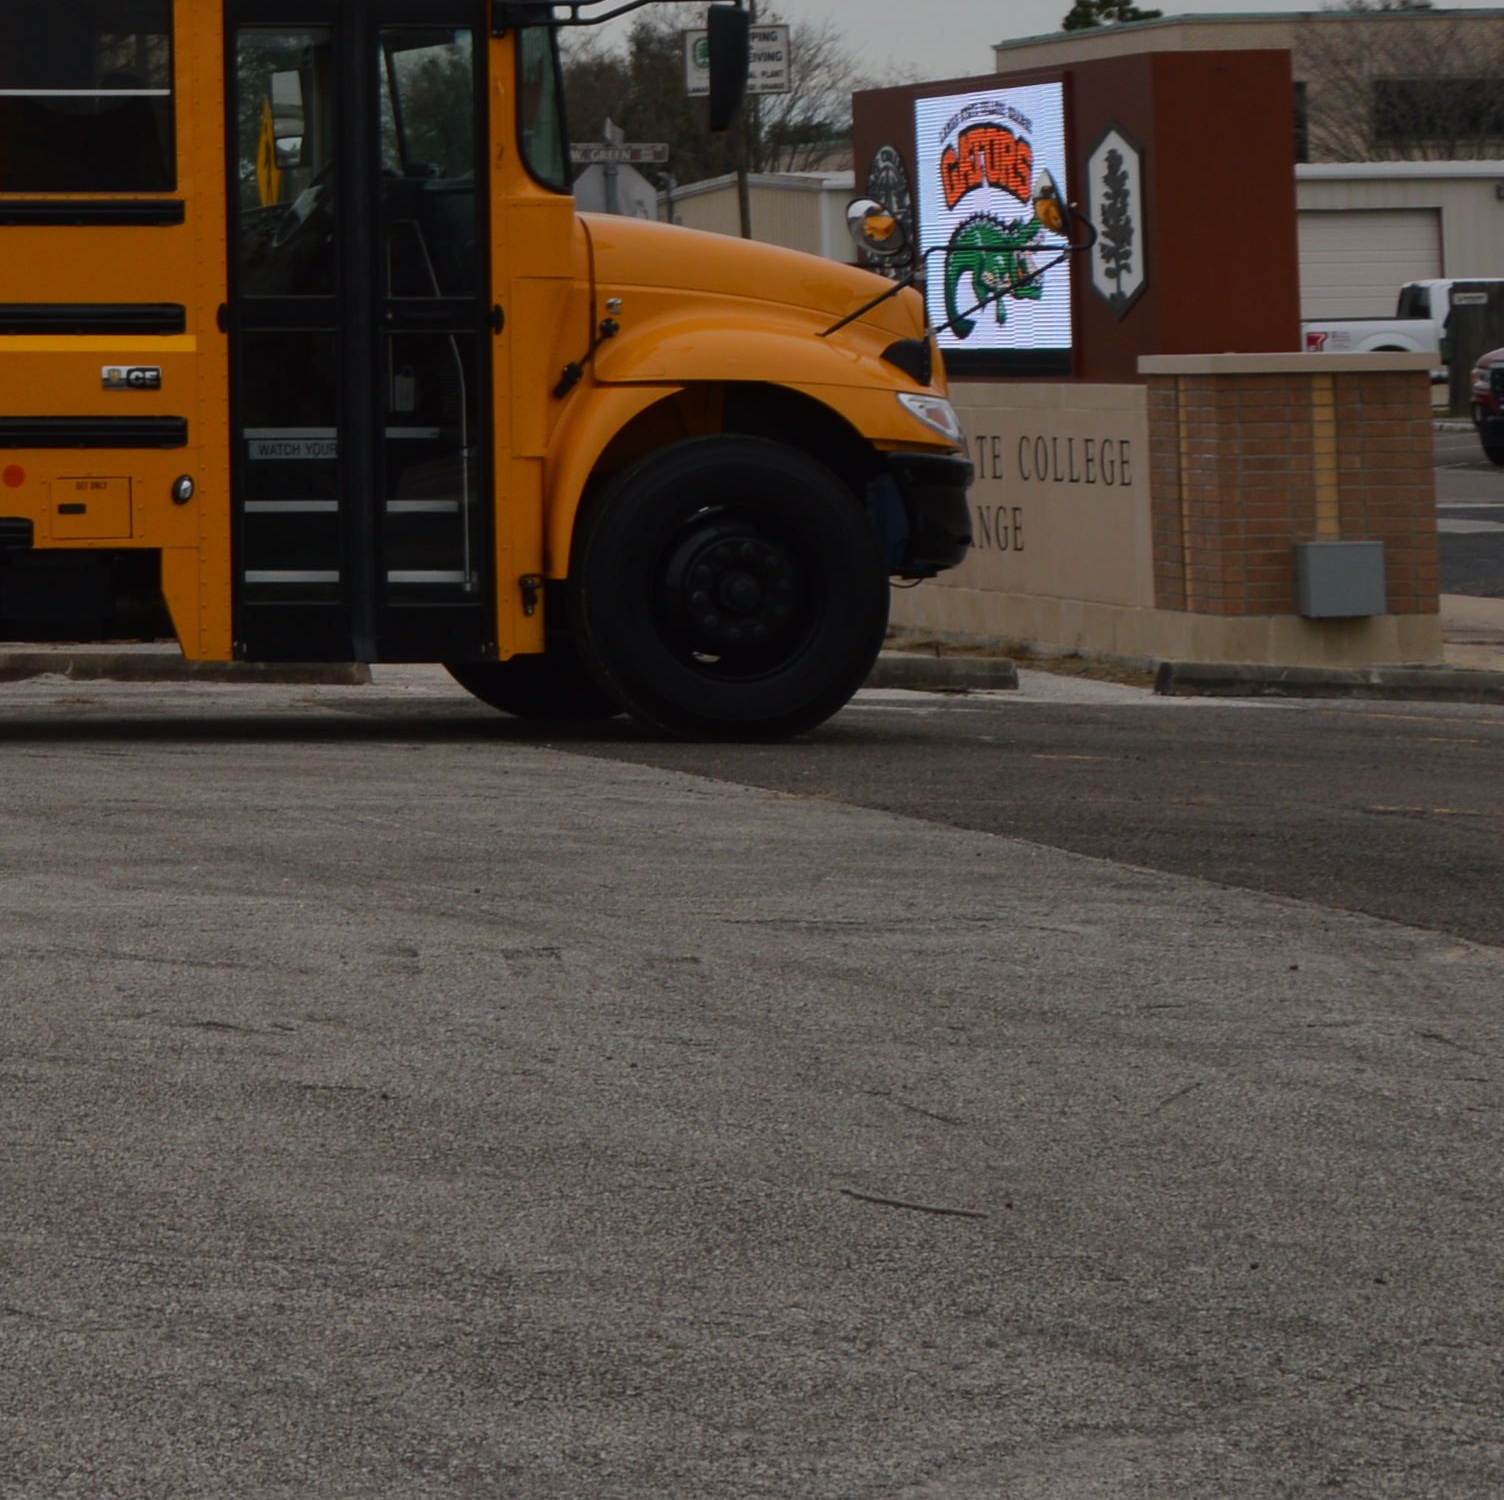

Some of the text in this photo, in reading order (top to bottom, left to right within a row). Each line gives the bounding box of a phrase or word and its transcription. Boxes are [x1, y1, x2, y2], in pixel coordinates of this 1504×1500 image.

[751, 31, 778, 42] PING
[749, 51, 783, 63] EIVING
[591, 149, 631, 161] GREEN
[940, 122, 1032, 210] GATORS
[129, 370, 158, 386] CE
[258, 443, 337, 456] WATCH YOUR
[1018, 435, 1132, 487] COLLEGE
[90, 481, 107, 491] ONLY
[971, 505, 1025, 552] NGE
